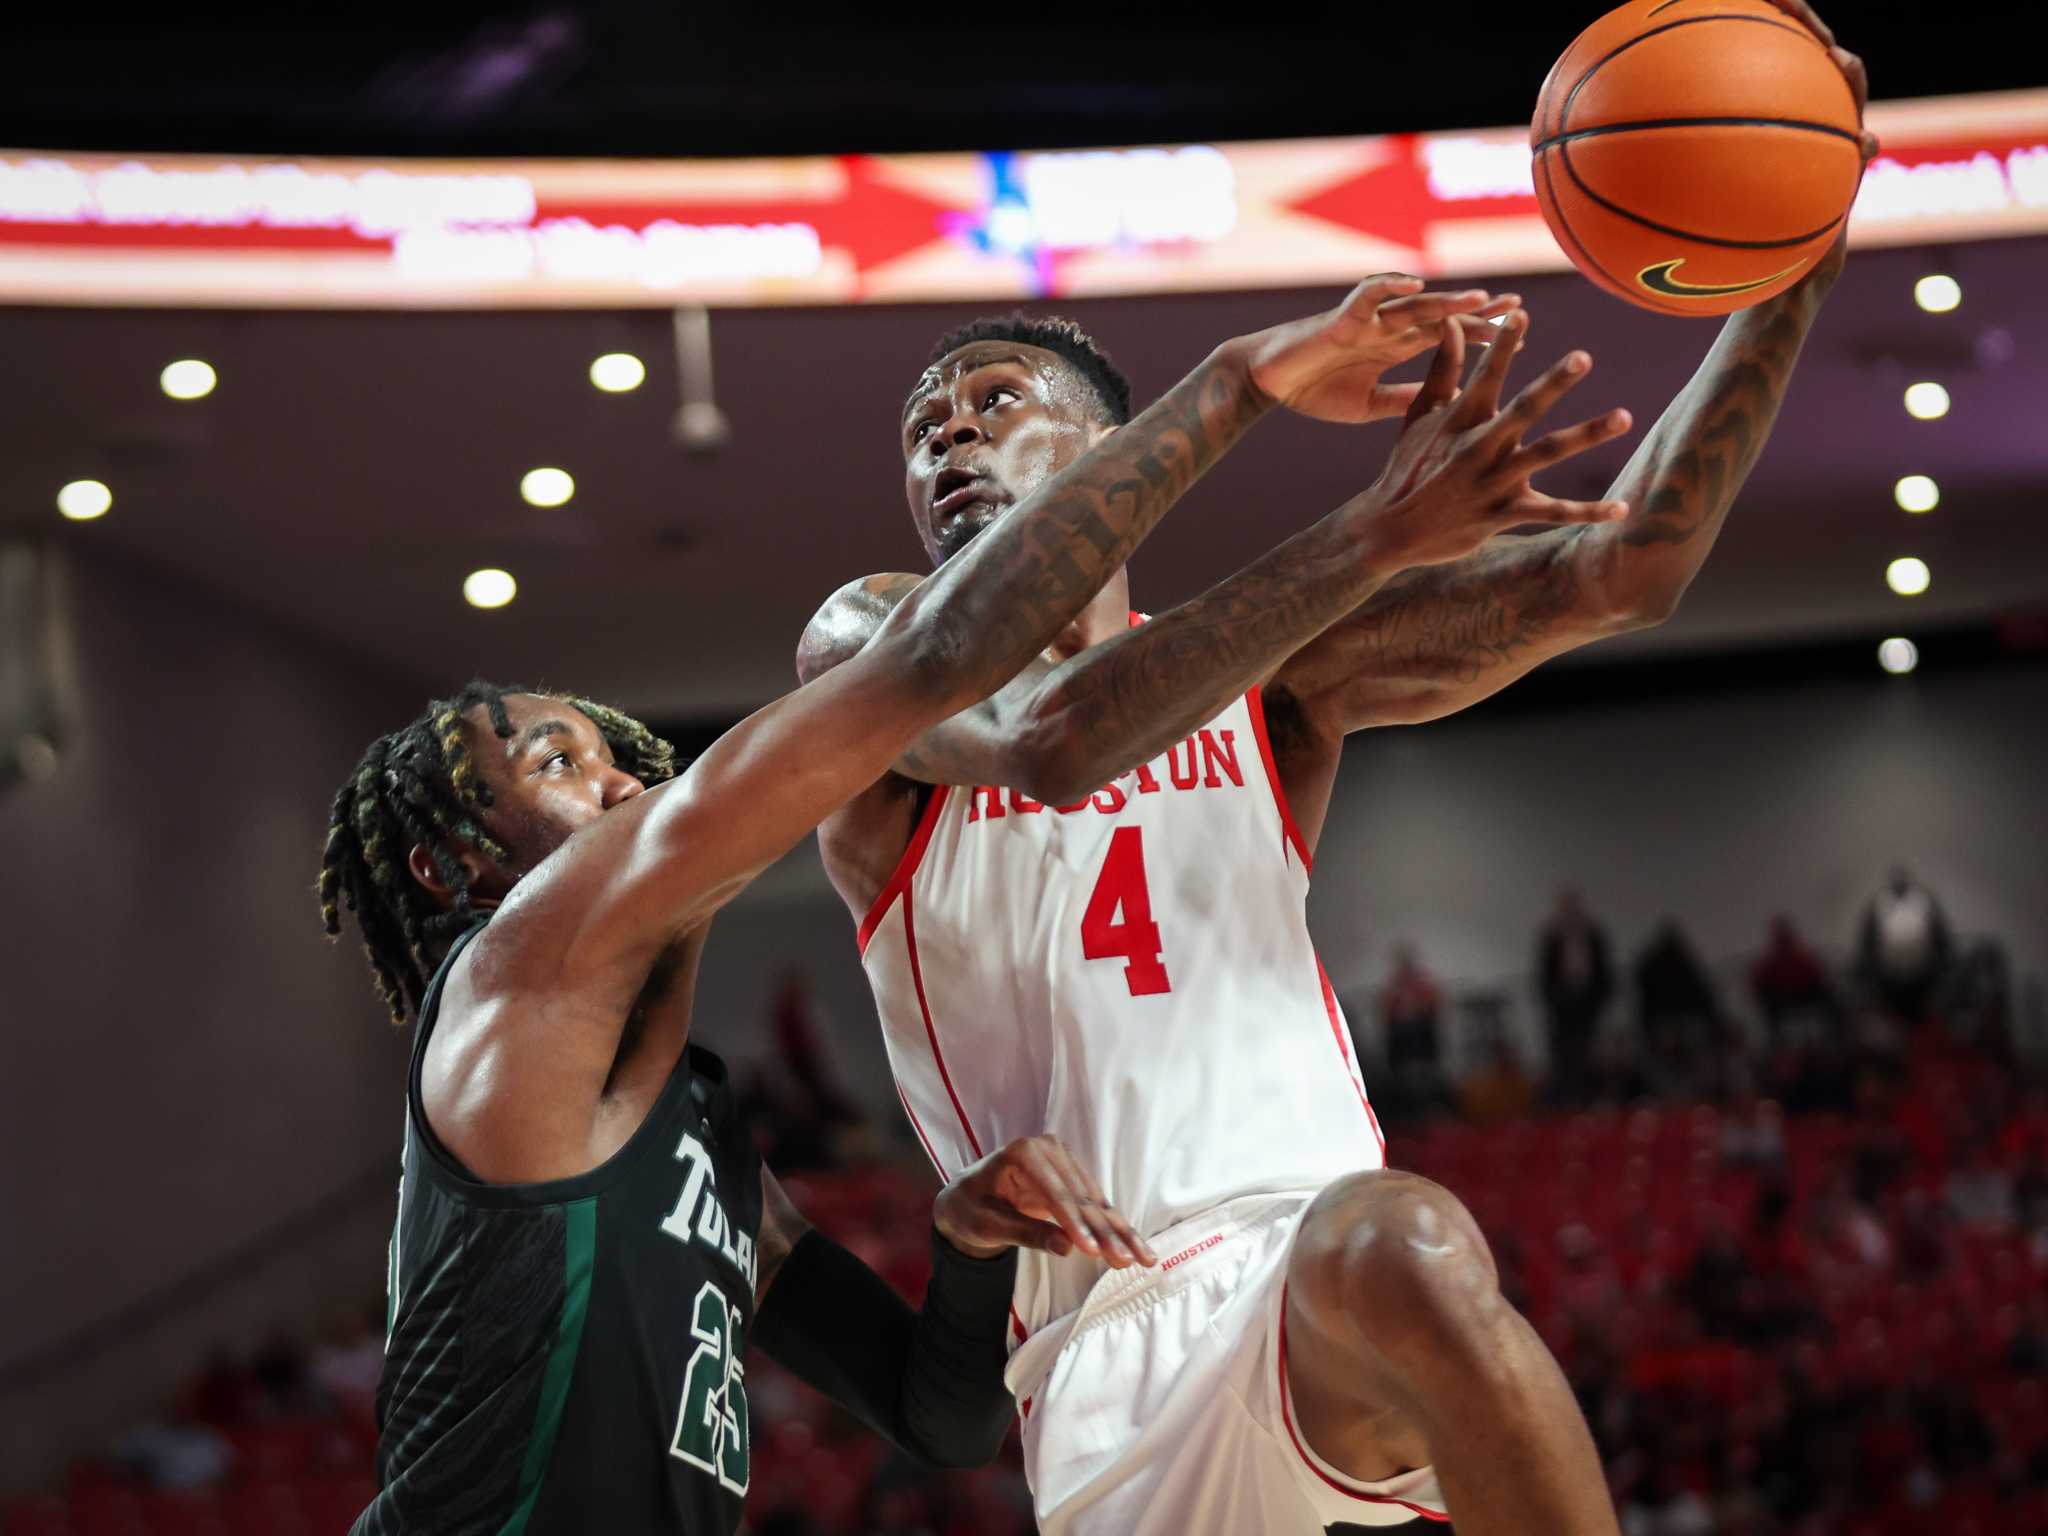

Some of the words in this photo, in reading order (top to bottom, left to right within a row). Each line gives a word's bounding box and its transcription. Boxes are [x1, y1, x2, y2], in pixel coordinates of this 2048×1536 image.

[1080, 825, 1172, 997] 4
[1160, 1232, 1225, 1272] HOUSTON
[669, 1280, 750, 1498] 25
